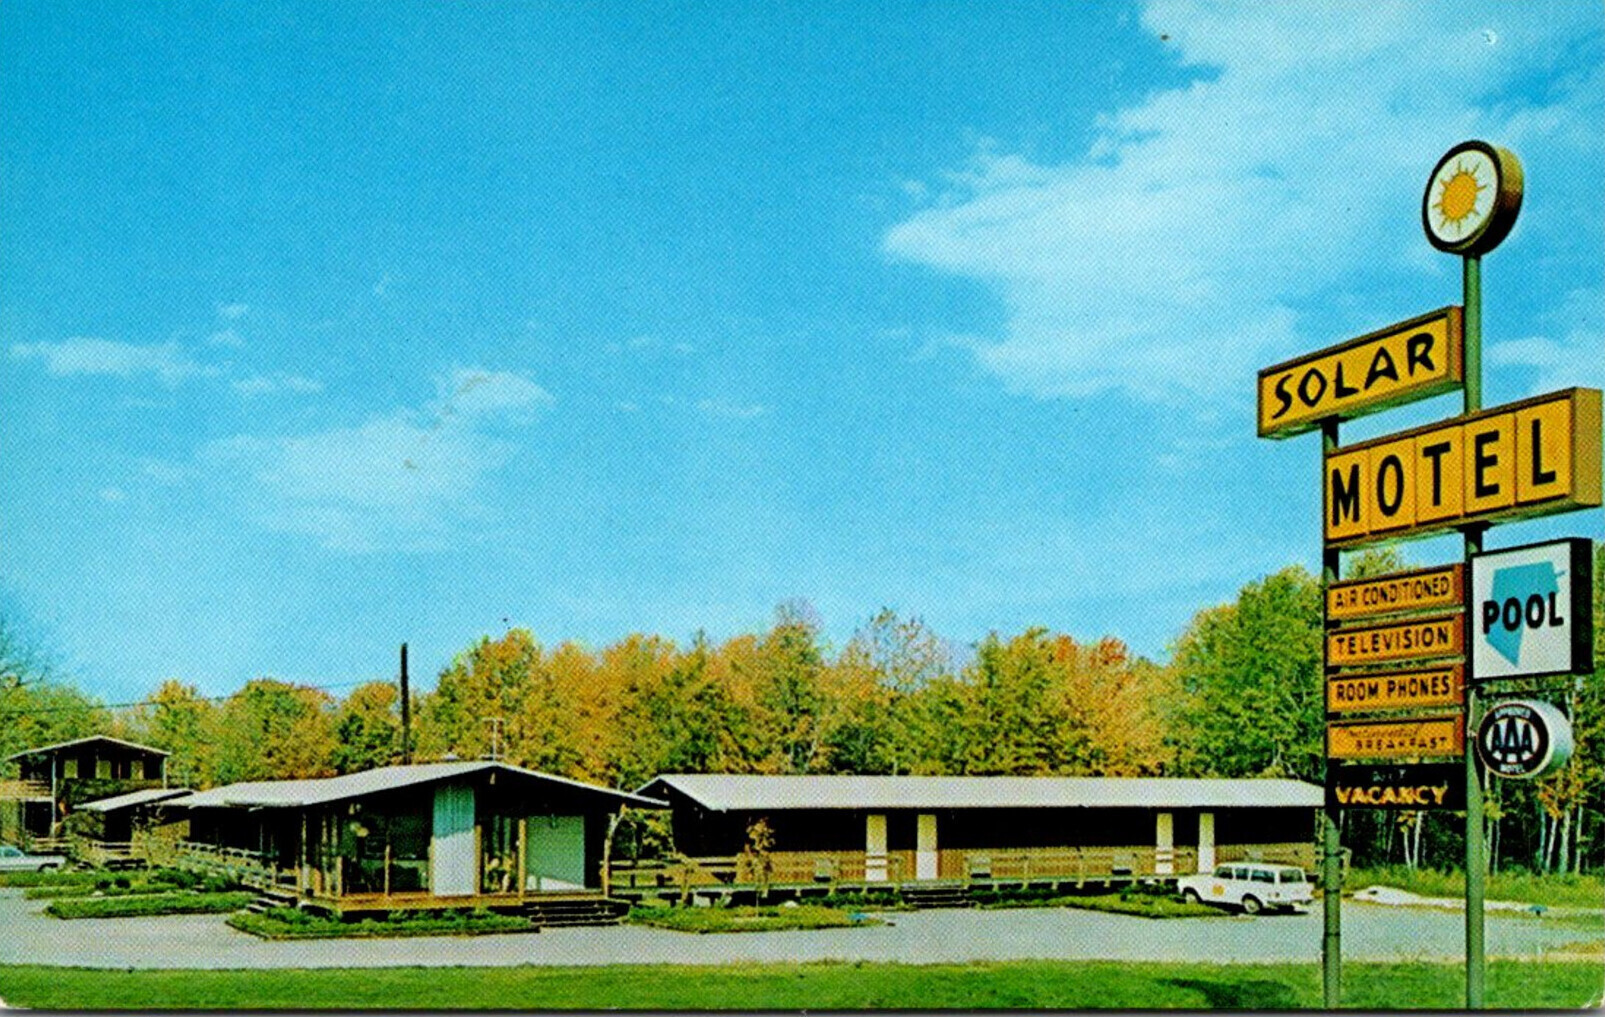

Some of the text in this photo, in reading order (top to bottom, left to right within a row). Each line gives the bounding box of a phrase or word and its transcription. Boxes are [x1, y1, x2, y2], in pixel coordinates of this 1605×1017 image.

[1272, 332, 1435, 420] SOLAR
[1332, 418, 1557, 528] MOTEL
[1335, 575, 1450, 608] AIR CONDITIONED
[1483, 591, 1564, 634] POOL
[1336, 626, 1449, 655] TELEVISION
[1336, 675, 1451, 701] ROOM PHONES
[1491, 716, 1534, 762] AAA
[1335, 784, 1449, 805] VACANCY
